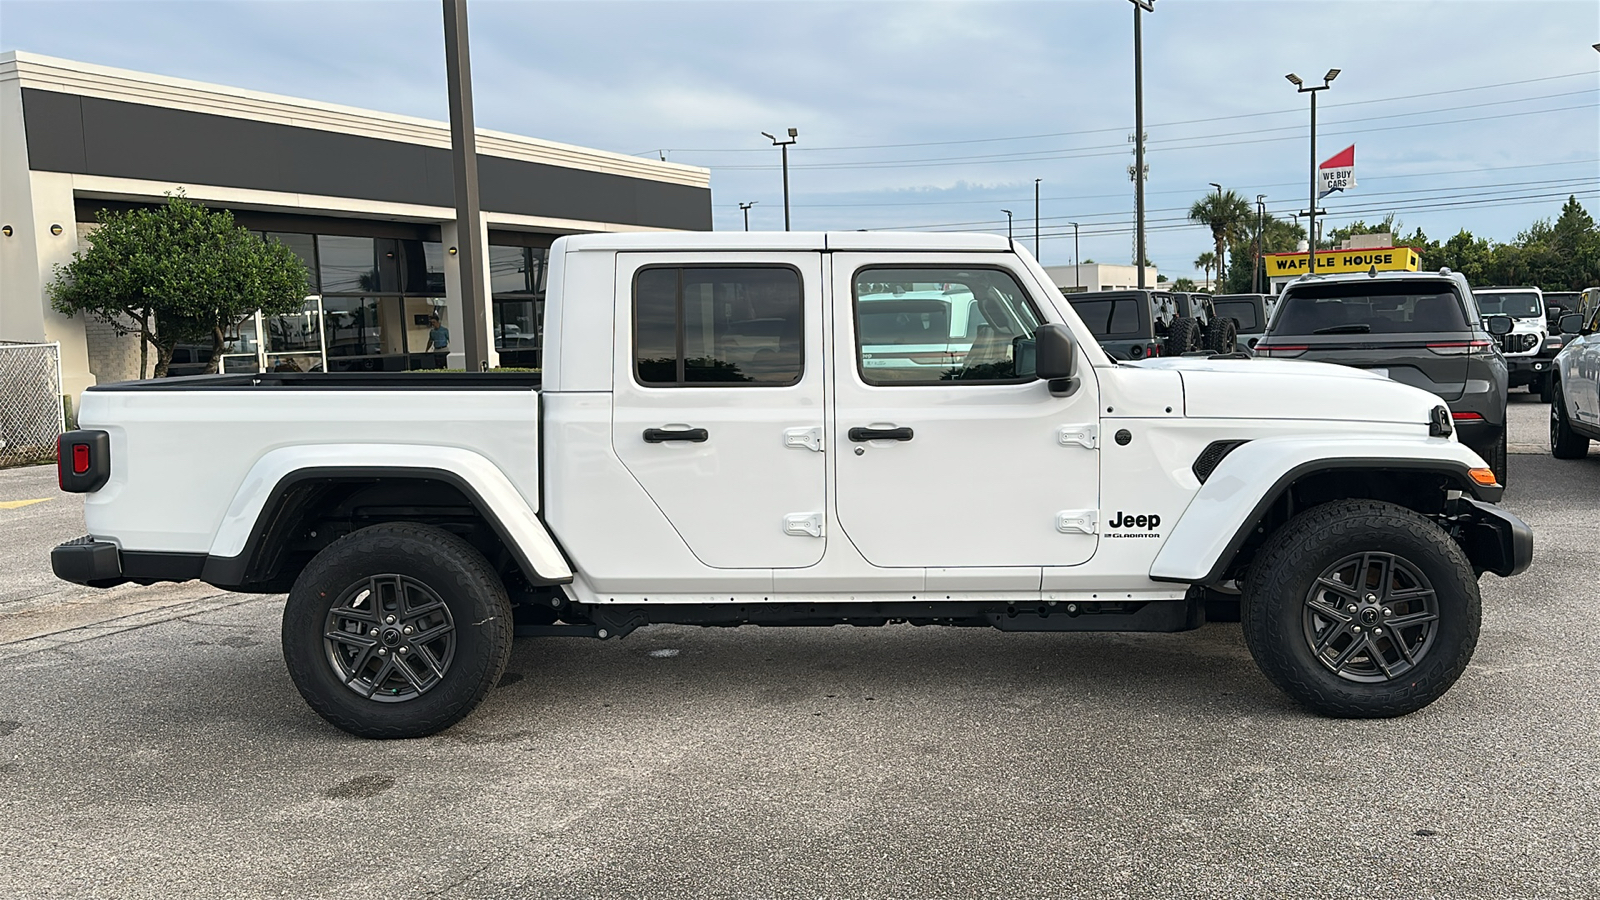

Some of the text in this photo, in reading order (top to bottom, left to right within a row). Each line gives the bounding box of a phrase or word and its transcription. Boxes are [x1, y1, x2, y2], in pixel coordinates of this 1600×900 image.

[1323, 170, 1352, 181] WE BUY
[1327, 179, 1347, 189] CARS
[1343, 253, 1393, 266] HOUSE
[1108, 511, 1161, 531] Jeep
